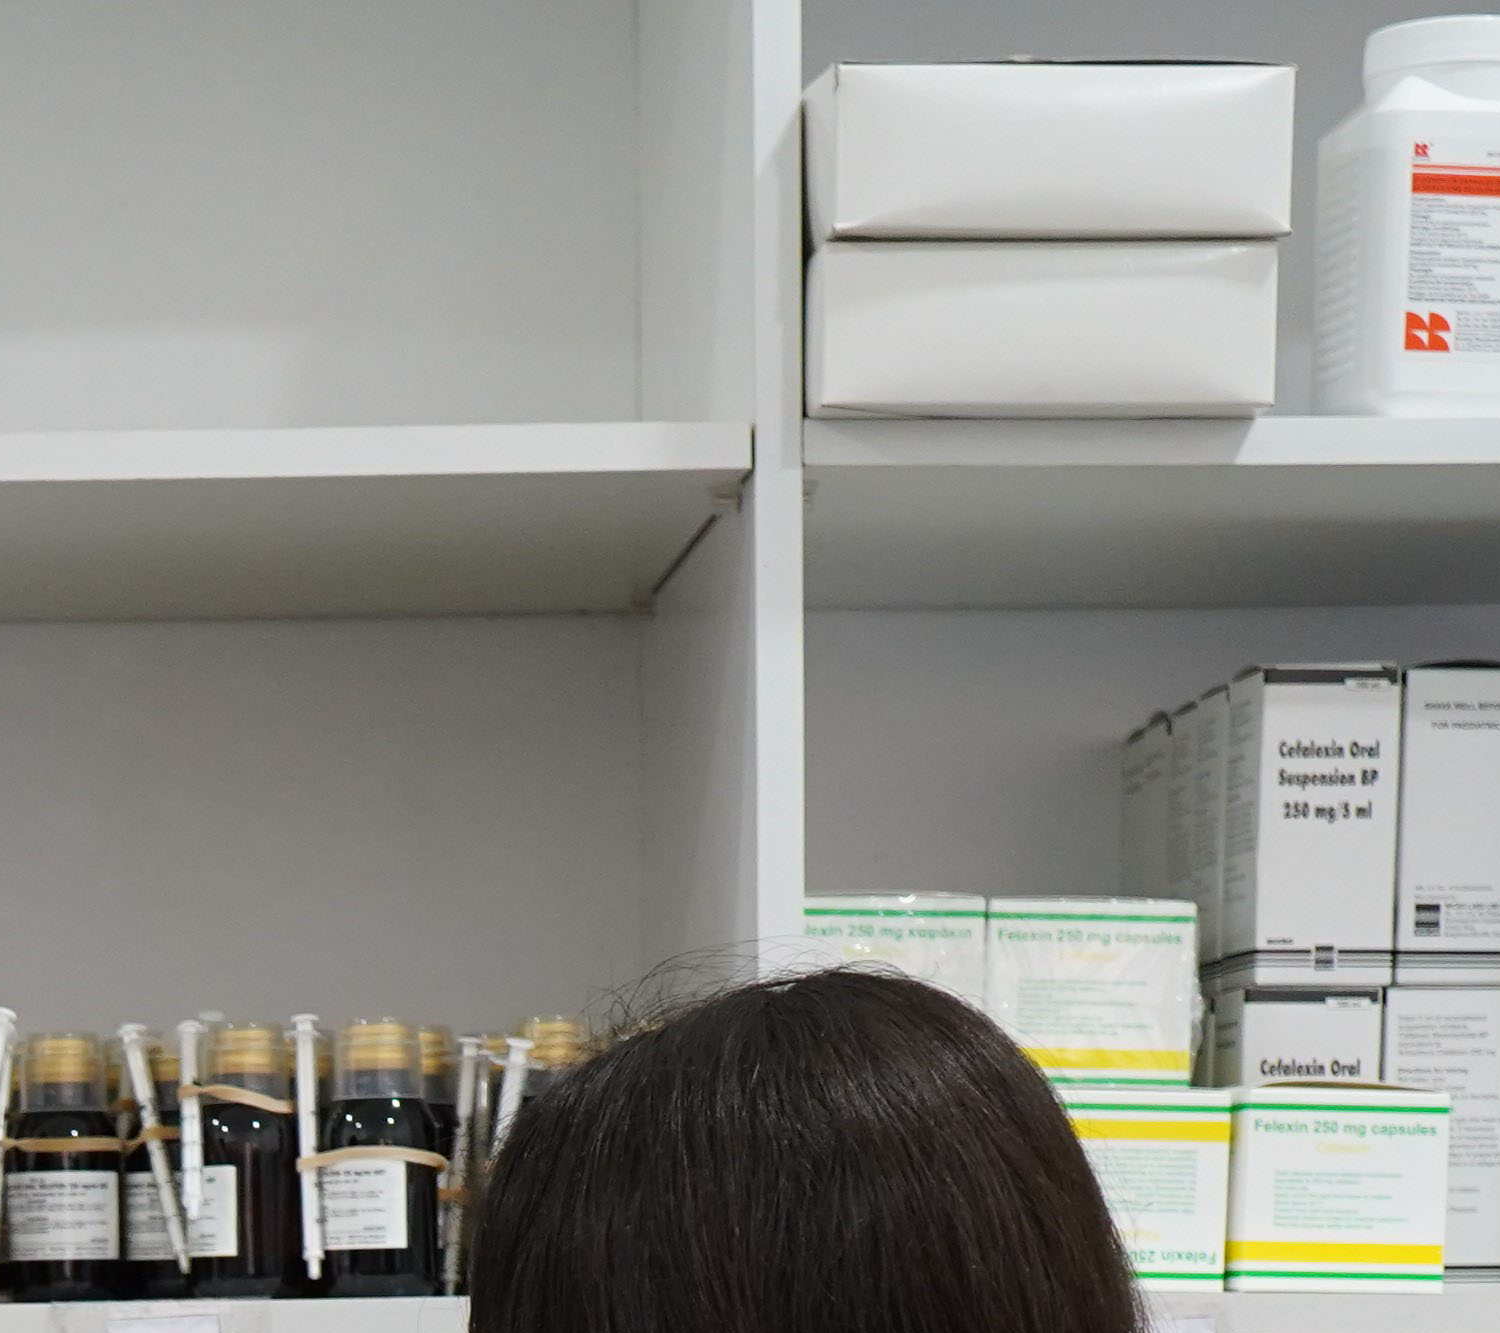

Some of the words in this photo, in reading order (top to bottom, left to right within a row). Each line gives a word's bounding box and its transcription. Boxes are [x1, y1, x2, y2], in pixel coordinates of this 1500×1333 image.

[1278, 740, 1344, 761] Cefalexin
[1350, 740, 1381, 760] Oral
[1278, 767, 1354, 789] Suspension
[1360, 768, 1379, 787] BP
[1283, 801, 1309, 820] 250
[1357, 801, 1372, 819] ml
[1259, 1056, 1326, 1079] Cefalexin
[1330, 1056, 1361, 1078] Oral
[1253, 1118, 1309, 1135] Felexin
[1313, 1120, 1338, 1136] 250
[1343, 1122, 1365, 1140] mg
[1369, 1120, 1438, 1140] capsules
